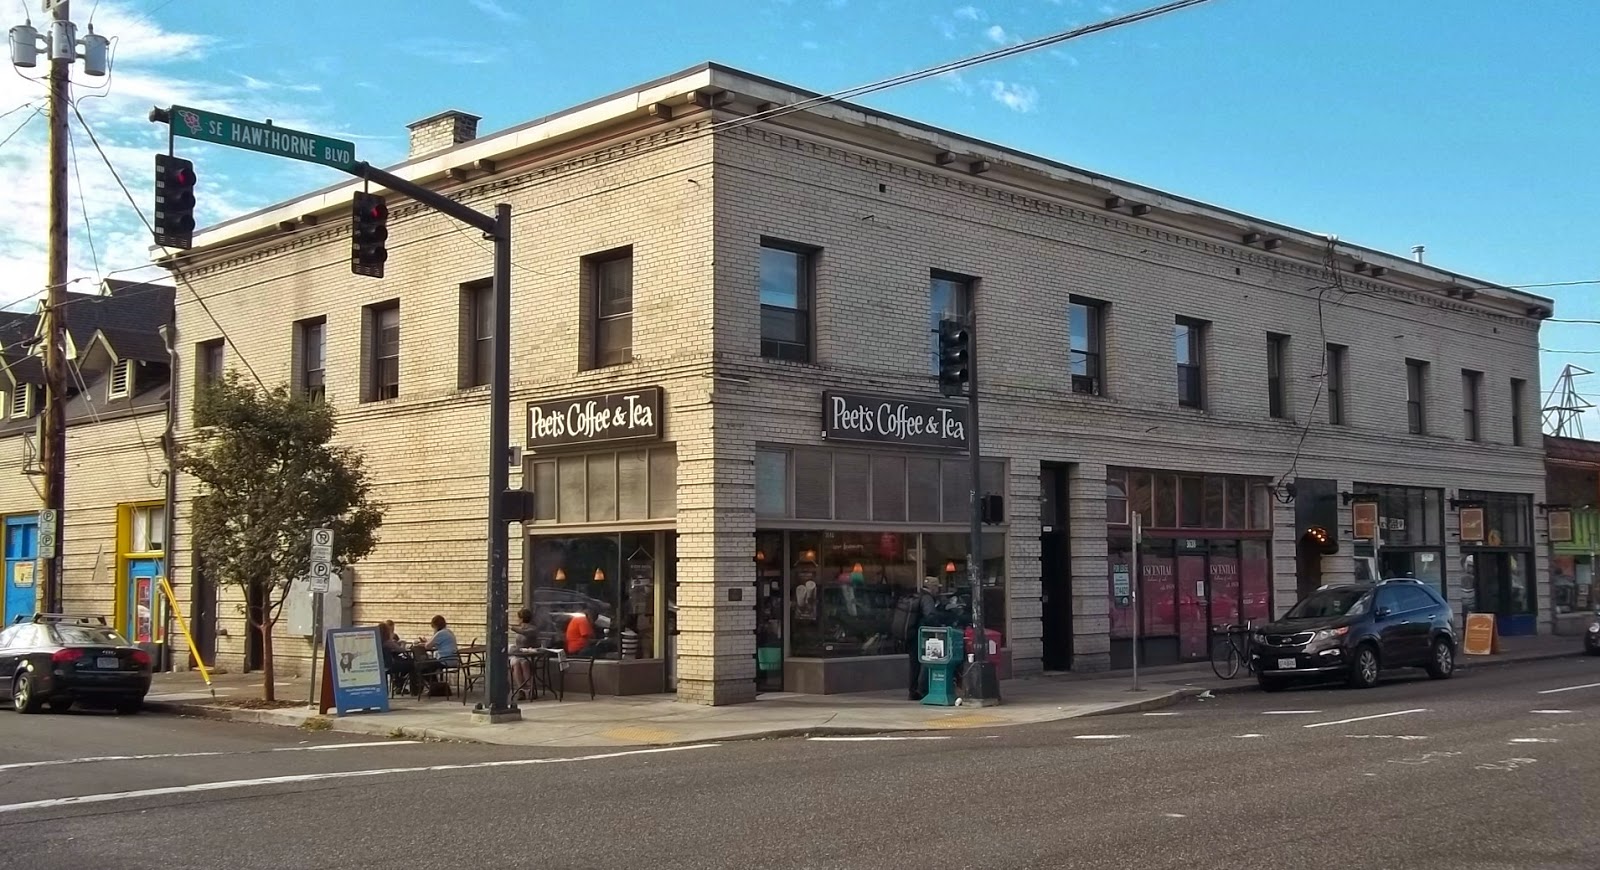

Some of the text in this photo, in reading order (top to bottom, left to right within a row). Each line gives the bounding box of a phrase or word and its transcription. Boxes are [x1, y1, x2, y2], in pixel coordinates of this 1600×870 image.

[208, 121, 350, 164] SE HAWTHORNE BLVD
[529, 395, 653, 438] Peet's Coffee & Tea
[831, 396, 965, 440] Peet's Coffee & Tea
